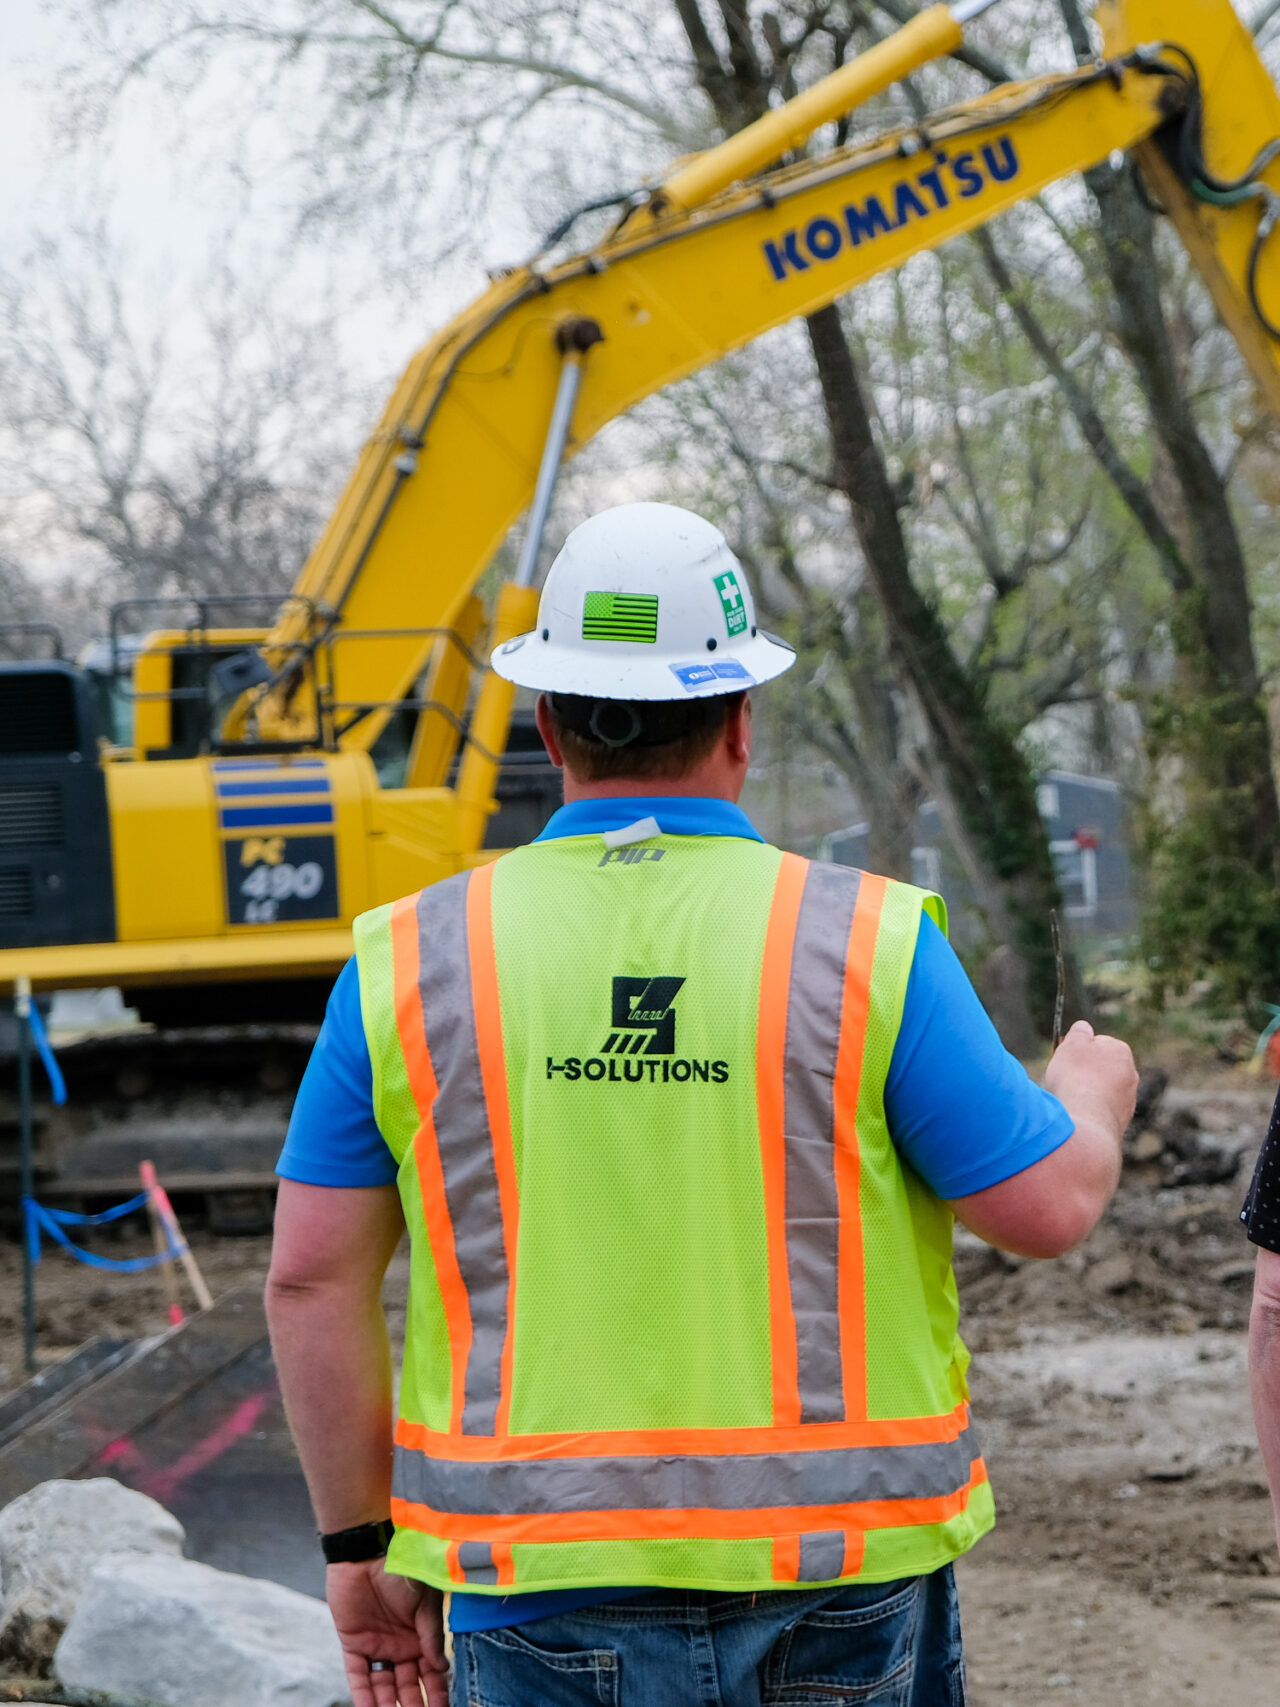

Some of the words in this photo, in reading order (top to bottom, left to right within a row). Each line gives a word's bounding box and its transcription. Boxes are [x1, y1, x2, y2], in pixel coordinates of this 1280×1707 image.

[764, 137, 1018, 281] KOMATSU
[240, 861, 324, 900] 490
[546, 1056, 730, 1083] I-SOLUTIONS
